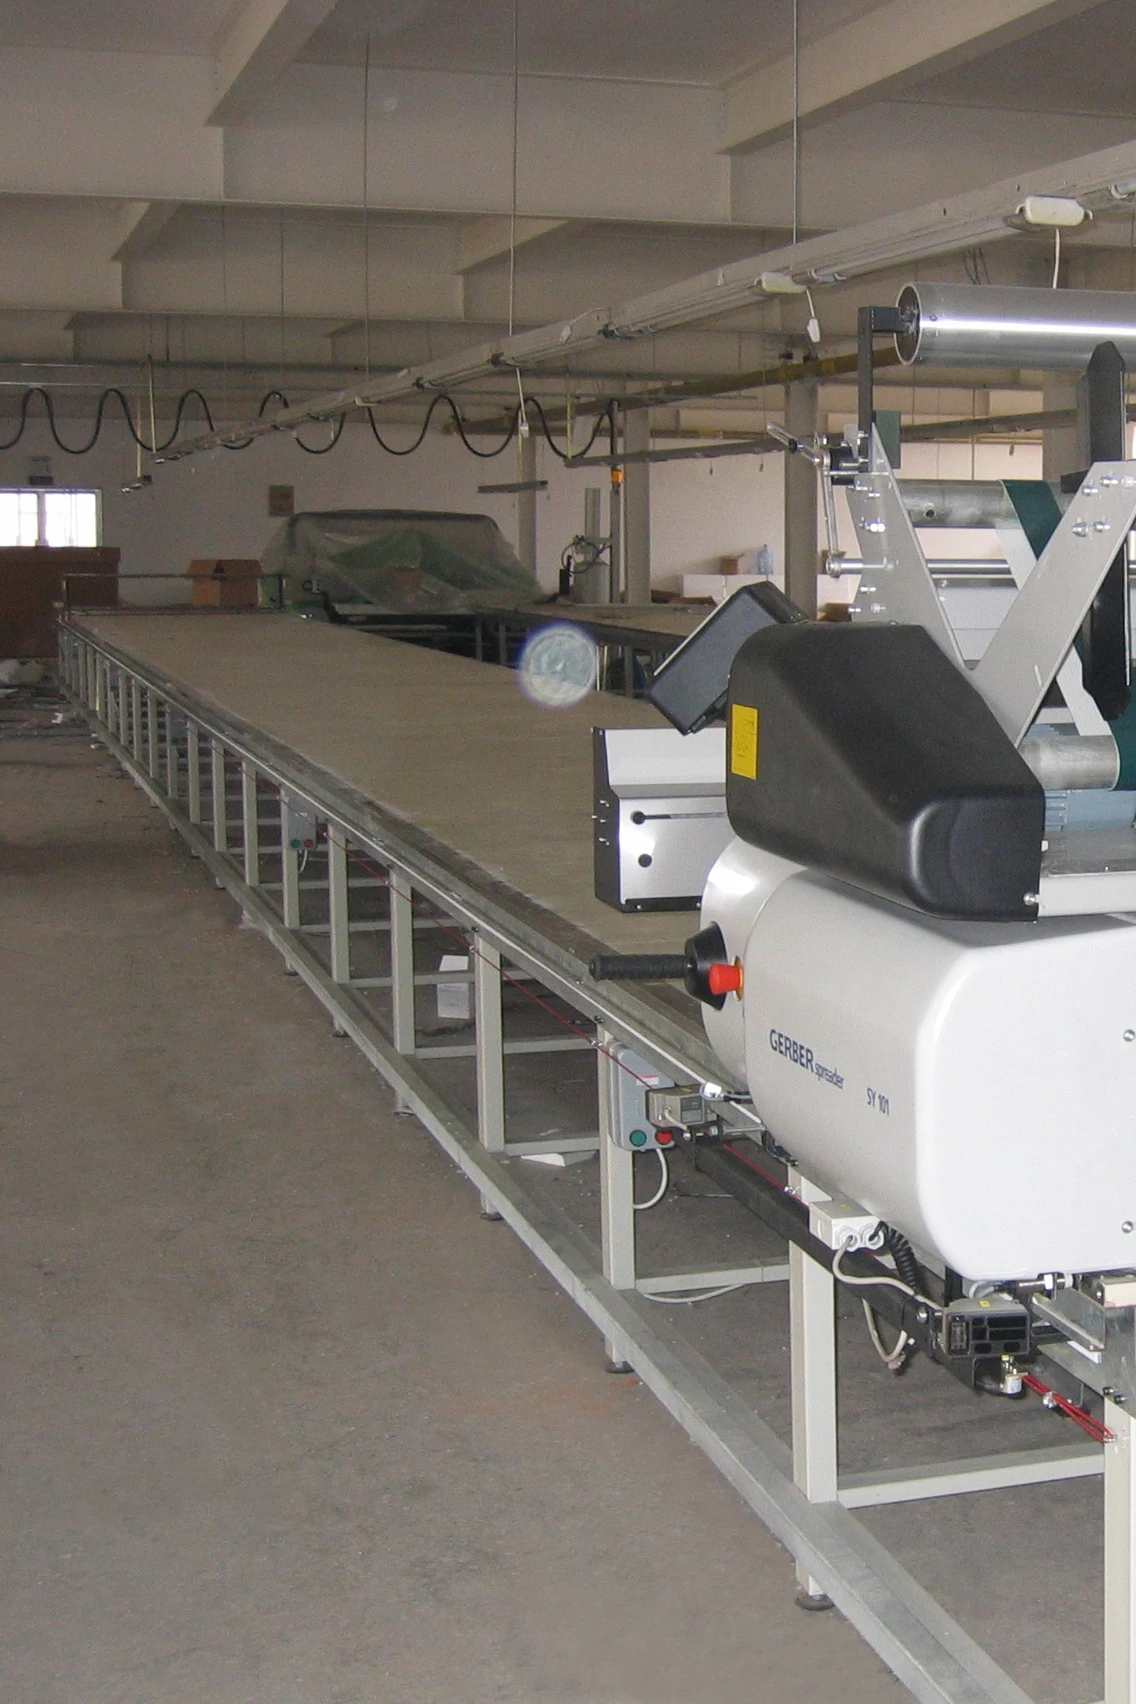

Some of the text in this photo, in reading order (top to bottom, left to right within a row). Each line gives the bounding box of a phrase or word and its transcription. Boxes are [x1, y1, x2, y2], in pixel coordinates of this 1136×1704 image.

[769, 1028, 844, 1091] GERBER spreader
[866, 1087, 891, 1117] SY 101
